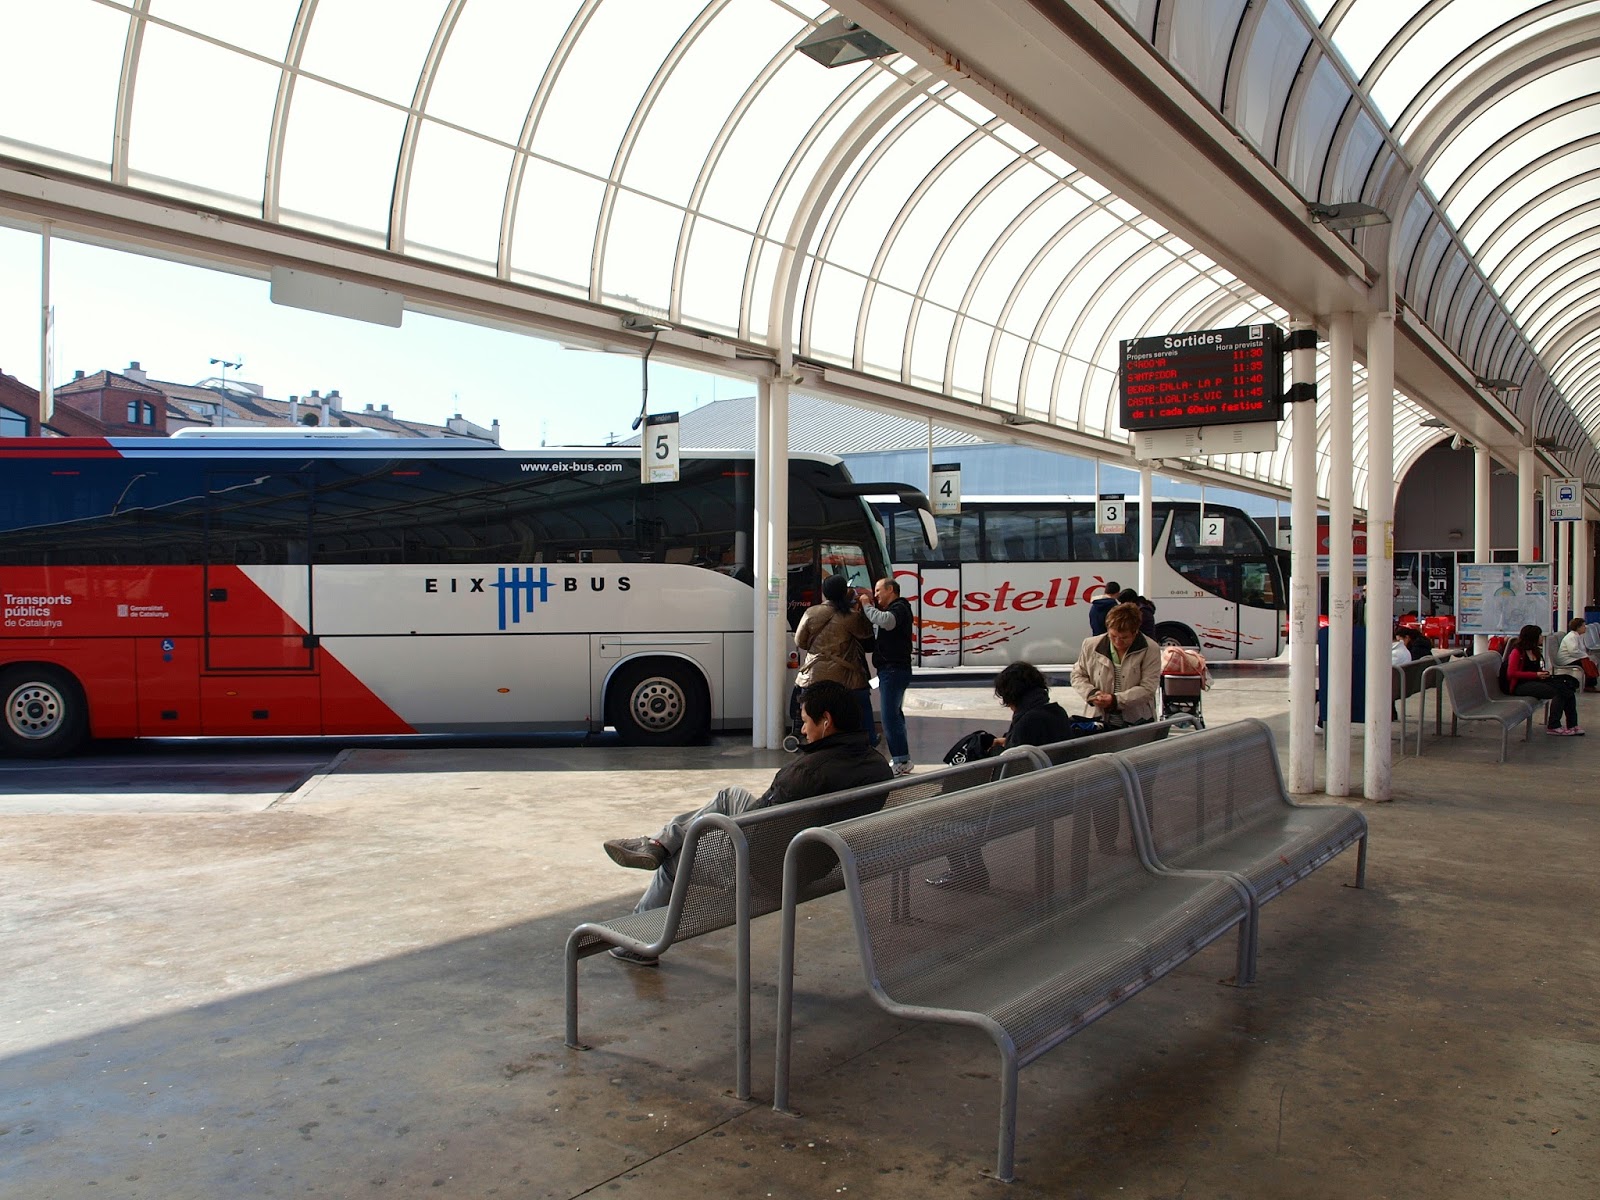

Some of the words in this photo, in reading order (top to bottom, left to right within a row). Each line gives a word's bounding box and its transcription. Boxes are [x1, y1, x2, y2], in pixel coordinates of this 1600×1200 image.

[1164, 333, 1223, 349] Sortides
[1235, 340, 1263, 351] prevista
[1233, 349, 1263, 359] 11:30
[1233, 362, 1263, 372] 11:35
[1215, 378, 1223, 386] P
[1233, 375, 1263, 385] 11:40
[1233, 388, 1263, 398] 11:45
[1159, 406, 1183, 416] cada
[1187, 405, 1217, 415] 60min
[1221, 402, 1263, 411] festius
[656, 435, 669, 459] 5
[521, 462, 622, 472] www.eix-bus.com
[940, 480, 952, 497] 4
[1107, 507, 1117, 521] 3
[1209, 524, 1217, 535] 2
[1527, 568, 1532, 576] 2
[425, 578, 485, 593] EIX
[564, 577, 631, 592] BUS
[891, 569, 1108, 612] Castellò
[1526, 583, 1532, 591] 8
[4, 594, 72, 606] Transports
[4, 606, 50, 618] públics
[18, 619, 62, 628] Catalunya
